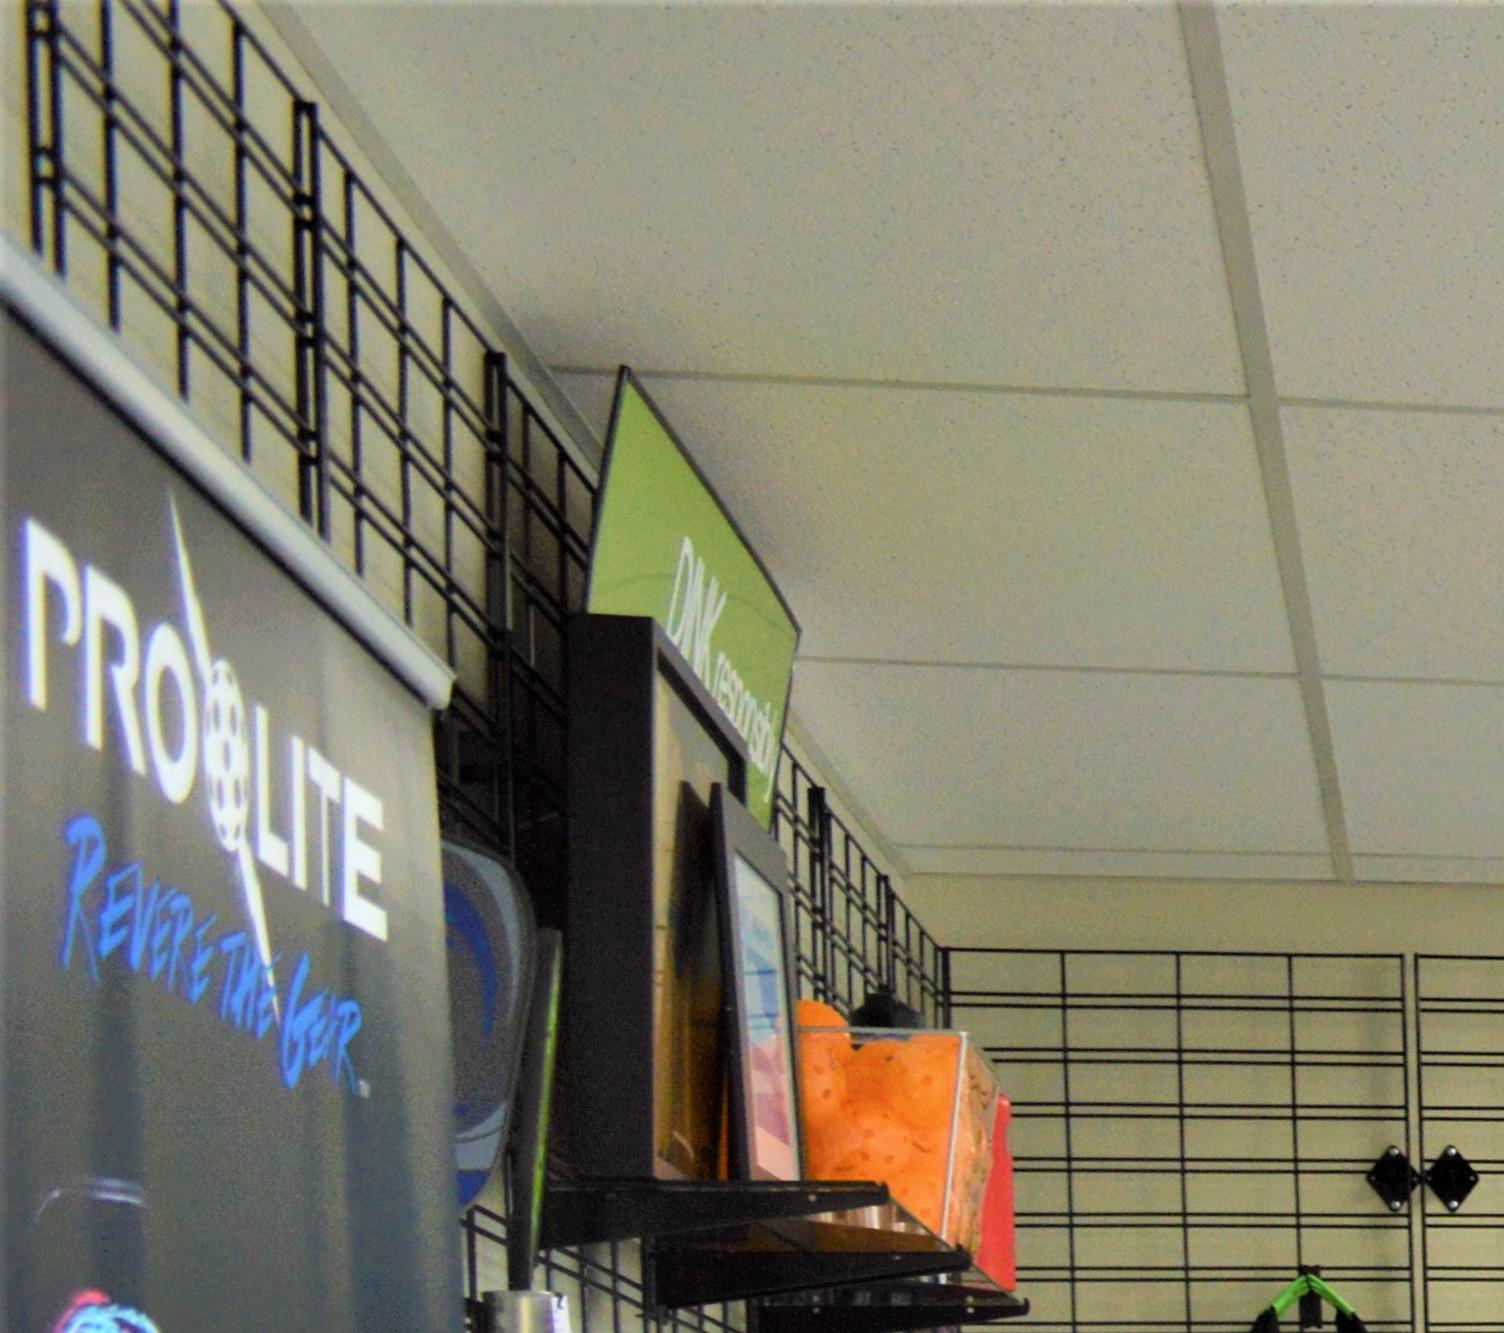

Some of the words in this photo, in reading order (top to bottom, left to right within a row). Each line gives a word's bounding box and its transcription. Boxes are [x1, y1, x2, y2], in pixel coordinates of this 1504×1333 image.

[25, 518, 197, 803] PRO
[254, 704, 388, 941] LITE
[61, 811, 218, 1004] REVERE
